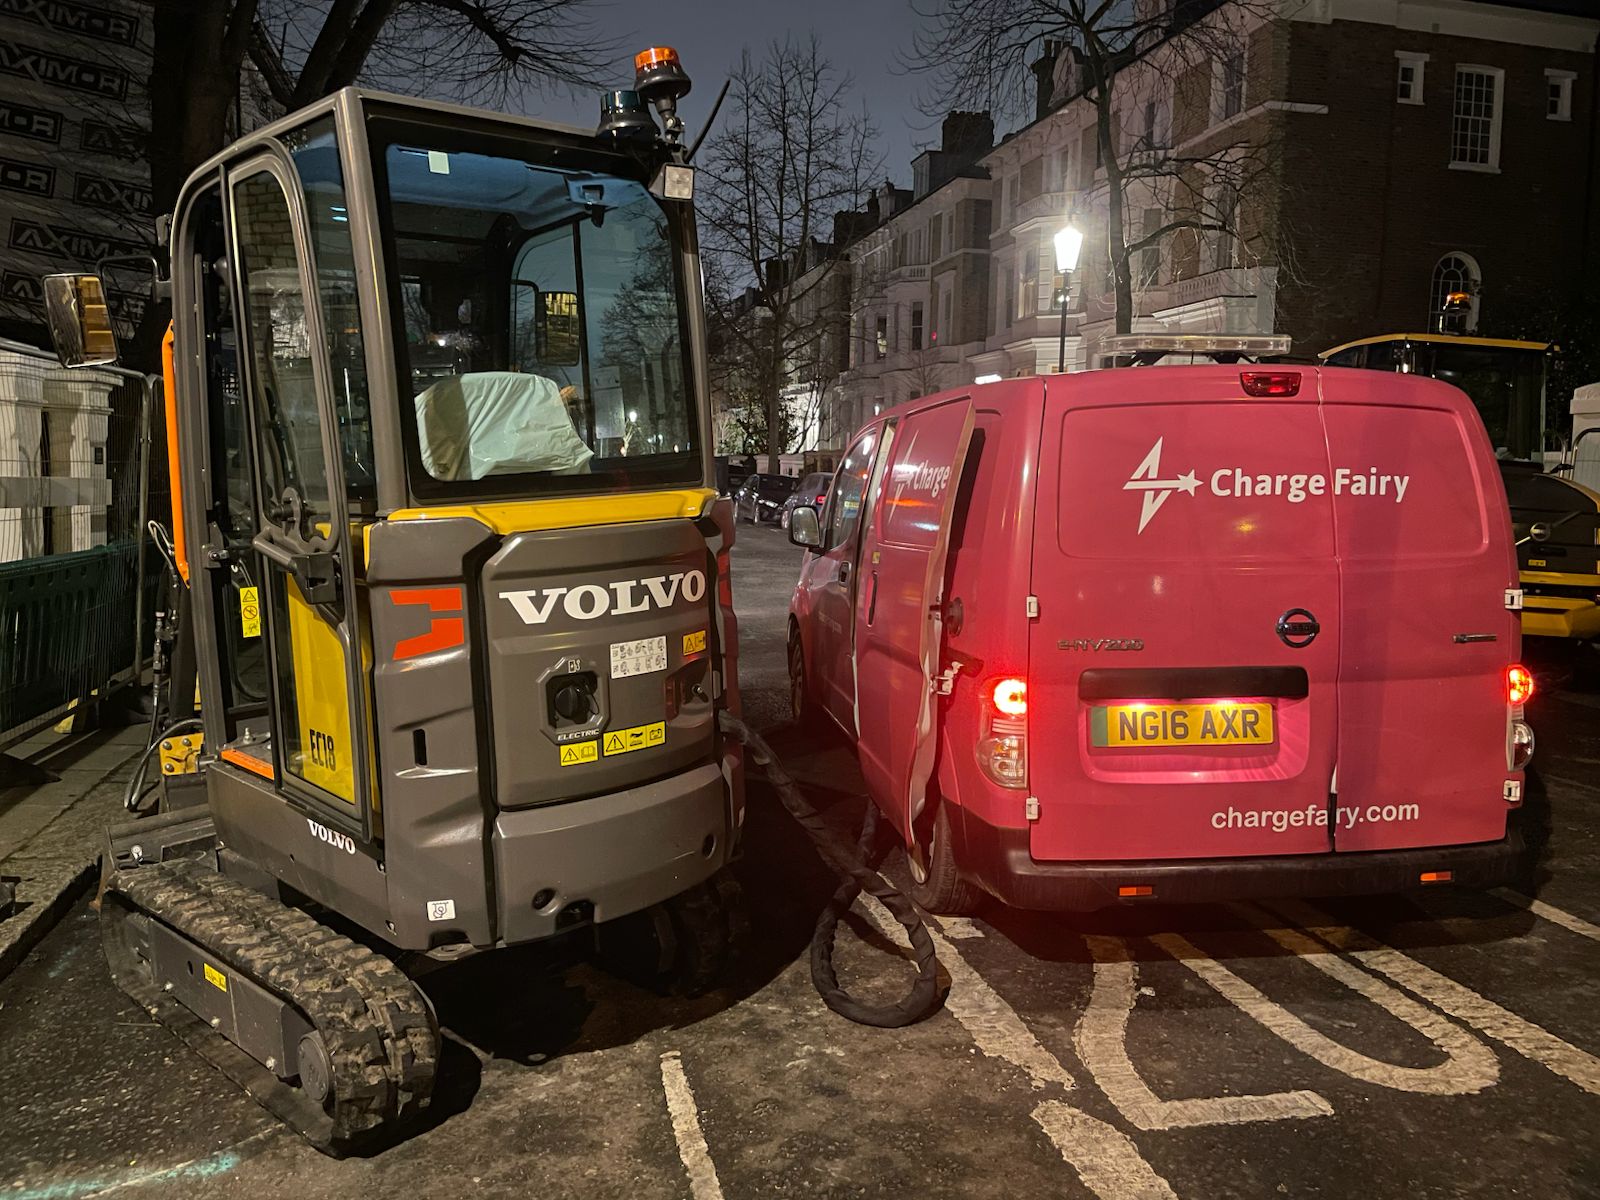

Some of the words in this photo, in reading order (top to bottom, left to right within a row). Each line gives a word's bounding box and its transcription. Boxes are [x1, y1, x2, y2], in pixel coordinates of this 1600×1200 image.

[913, 460, 950, 498] Charge
[1211, 468, 1326, 502] Charge
[1334, 467, 1410, 503] Fairy
[498, 570, 706, 624] VOLVO
[557, 729, 600, 741] ELECTRIC
[1119, 710, 1189, 741] NG16
[1200, 709, 1260, 739] AXR
[309, 728, 336, 772] EC18
[1211, 803, 1419, 832] chargefary.com
[307, 818, 356, 855] VOLVO
